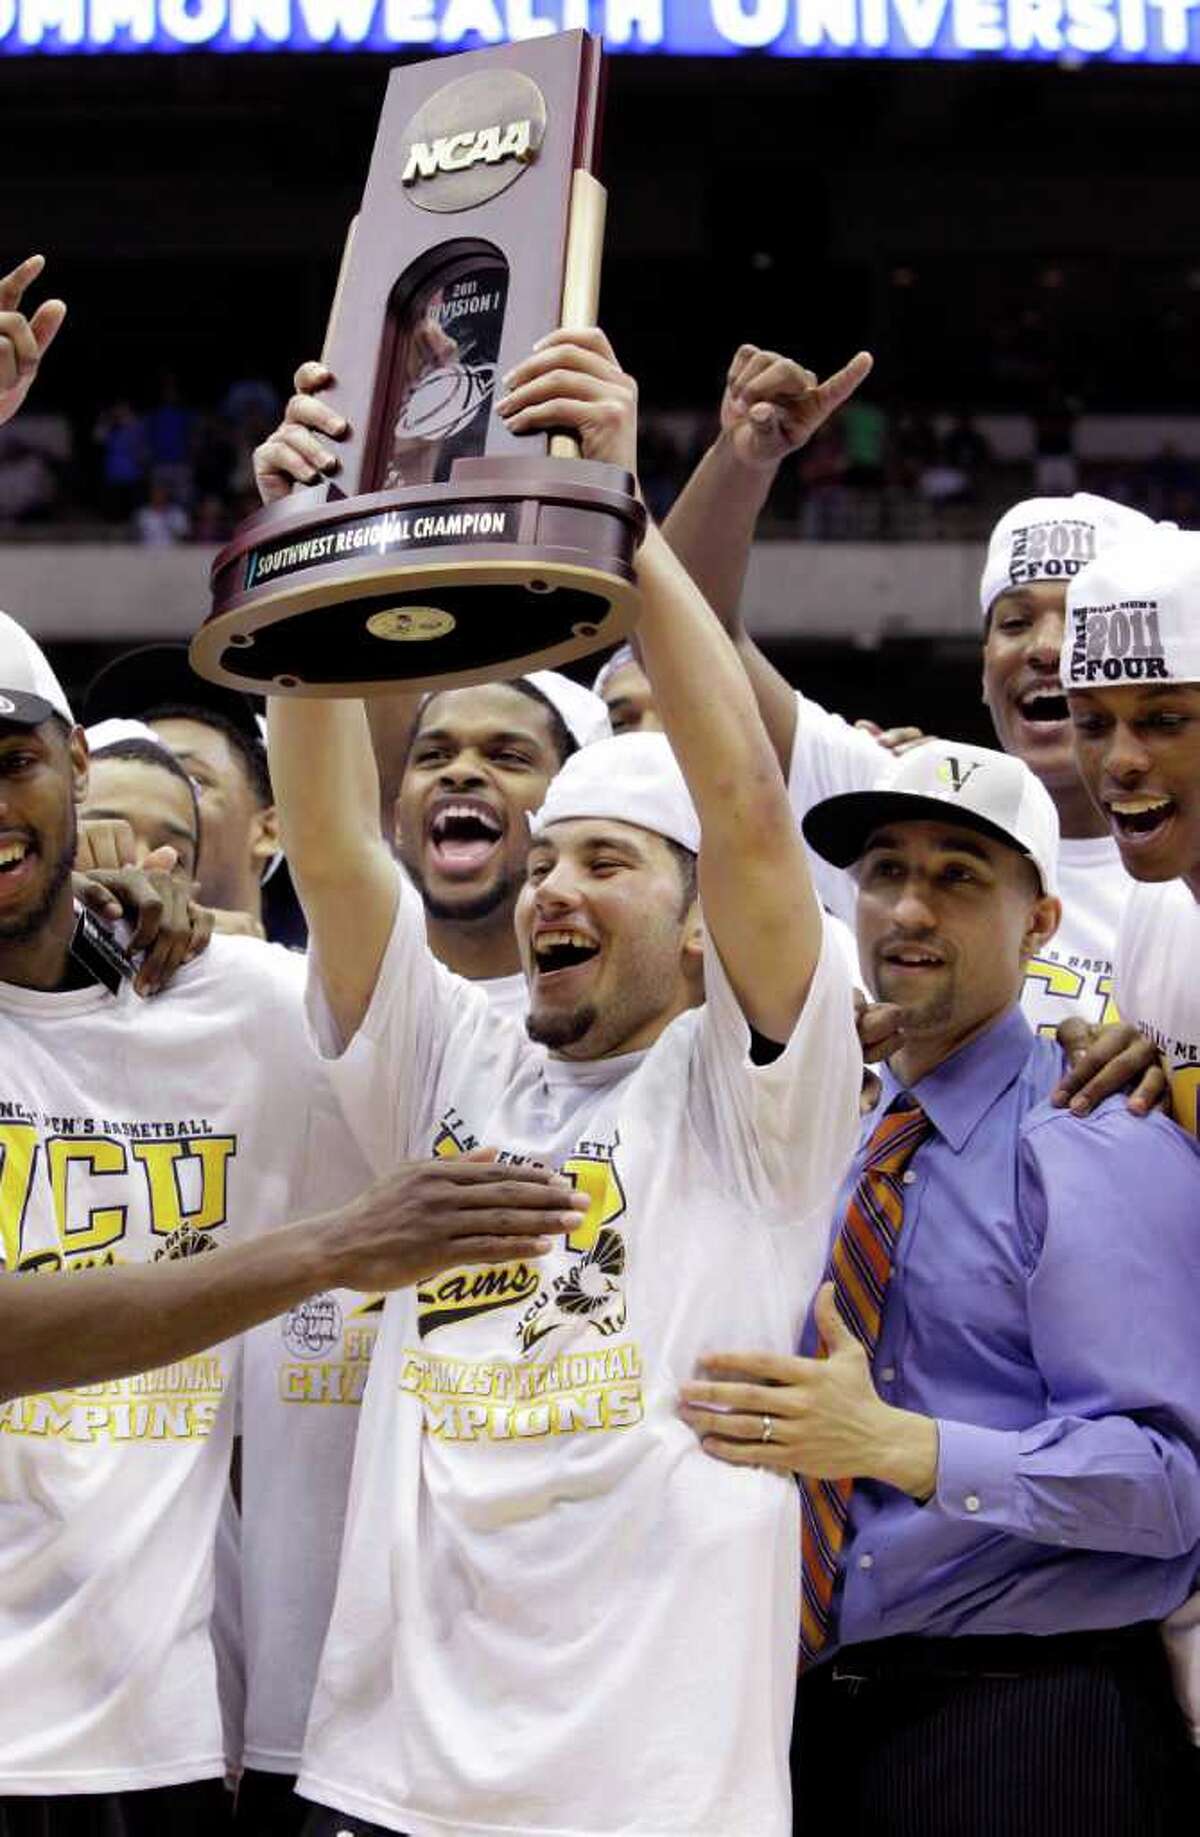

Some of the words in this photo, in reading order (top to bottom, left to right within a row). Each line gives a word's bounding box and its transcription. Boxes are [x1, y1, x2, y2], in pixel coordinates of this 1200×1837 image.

[0, 0, 664, 44] MMONWEALTH
[401, 120, 531, 182] NCAA
[256, 534, 333, 578] SOUTHWEST
[336, 514, 410, 552] REGIONAL
[414, 513, 506, 538] CHAMPION
[1028, 525, 1096, 560] 2011
[1027, 559, 1089, 578] FOU
[1071, 608, 1087, 682] FINAL
[1086, 610, 1165, 659] 2011
[1086, 658, 1169, 681] FOUR
[46, 1117, 94, 1135] EN'S
[417, 1263, 540, 1307] ams
